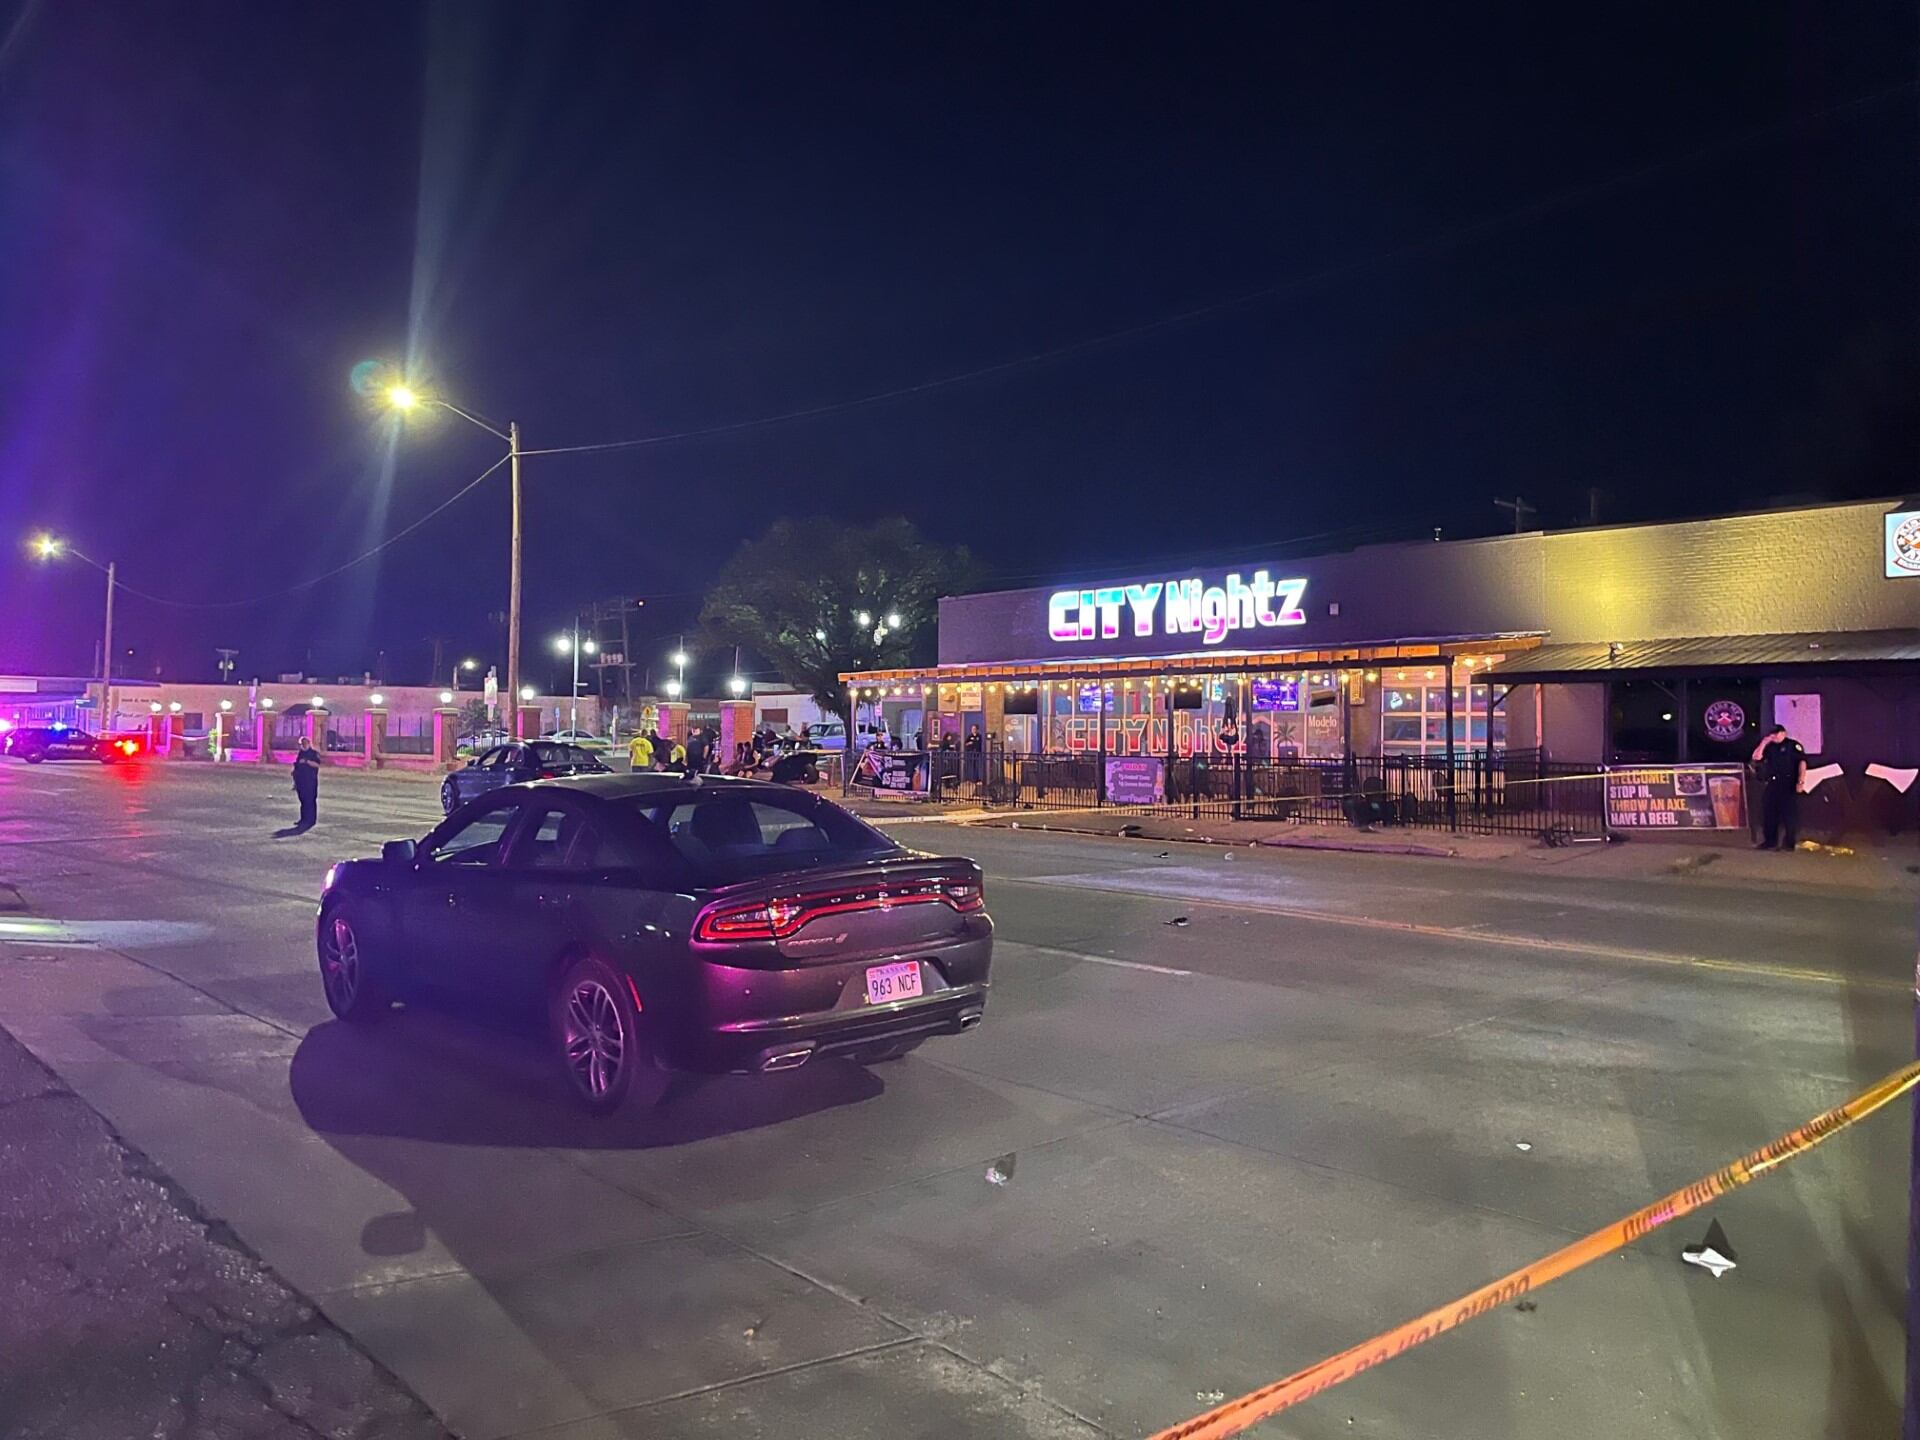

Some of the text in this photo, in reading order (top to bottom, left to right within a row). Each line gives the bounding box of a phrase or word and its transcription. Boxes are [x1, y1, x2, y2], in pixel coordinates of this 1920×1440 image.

[1048, 570, 1308, 645] CITY Nightz
[1308, 715, 1337, 728] Modelo
[1065, 718, 1148, 751] CITY
[1609, 785, 1653, 798] STOP IN.
[1610, 798, 1689, 811] THROW AN AXE.
[1610, 812, 1638, 825] HAVE
[1639, 812, 1648, 825] A
[1648, 811, 1679, 825] BEER.
[871, 973, 917, 997] 963 NCF
